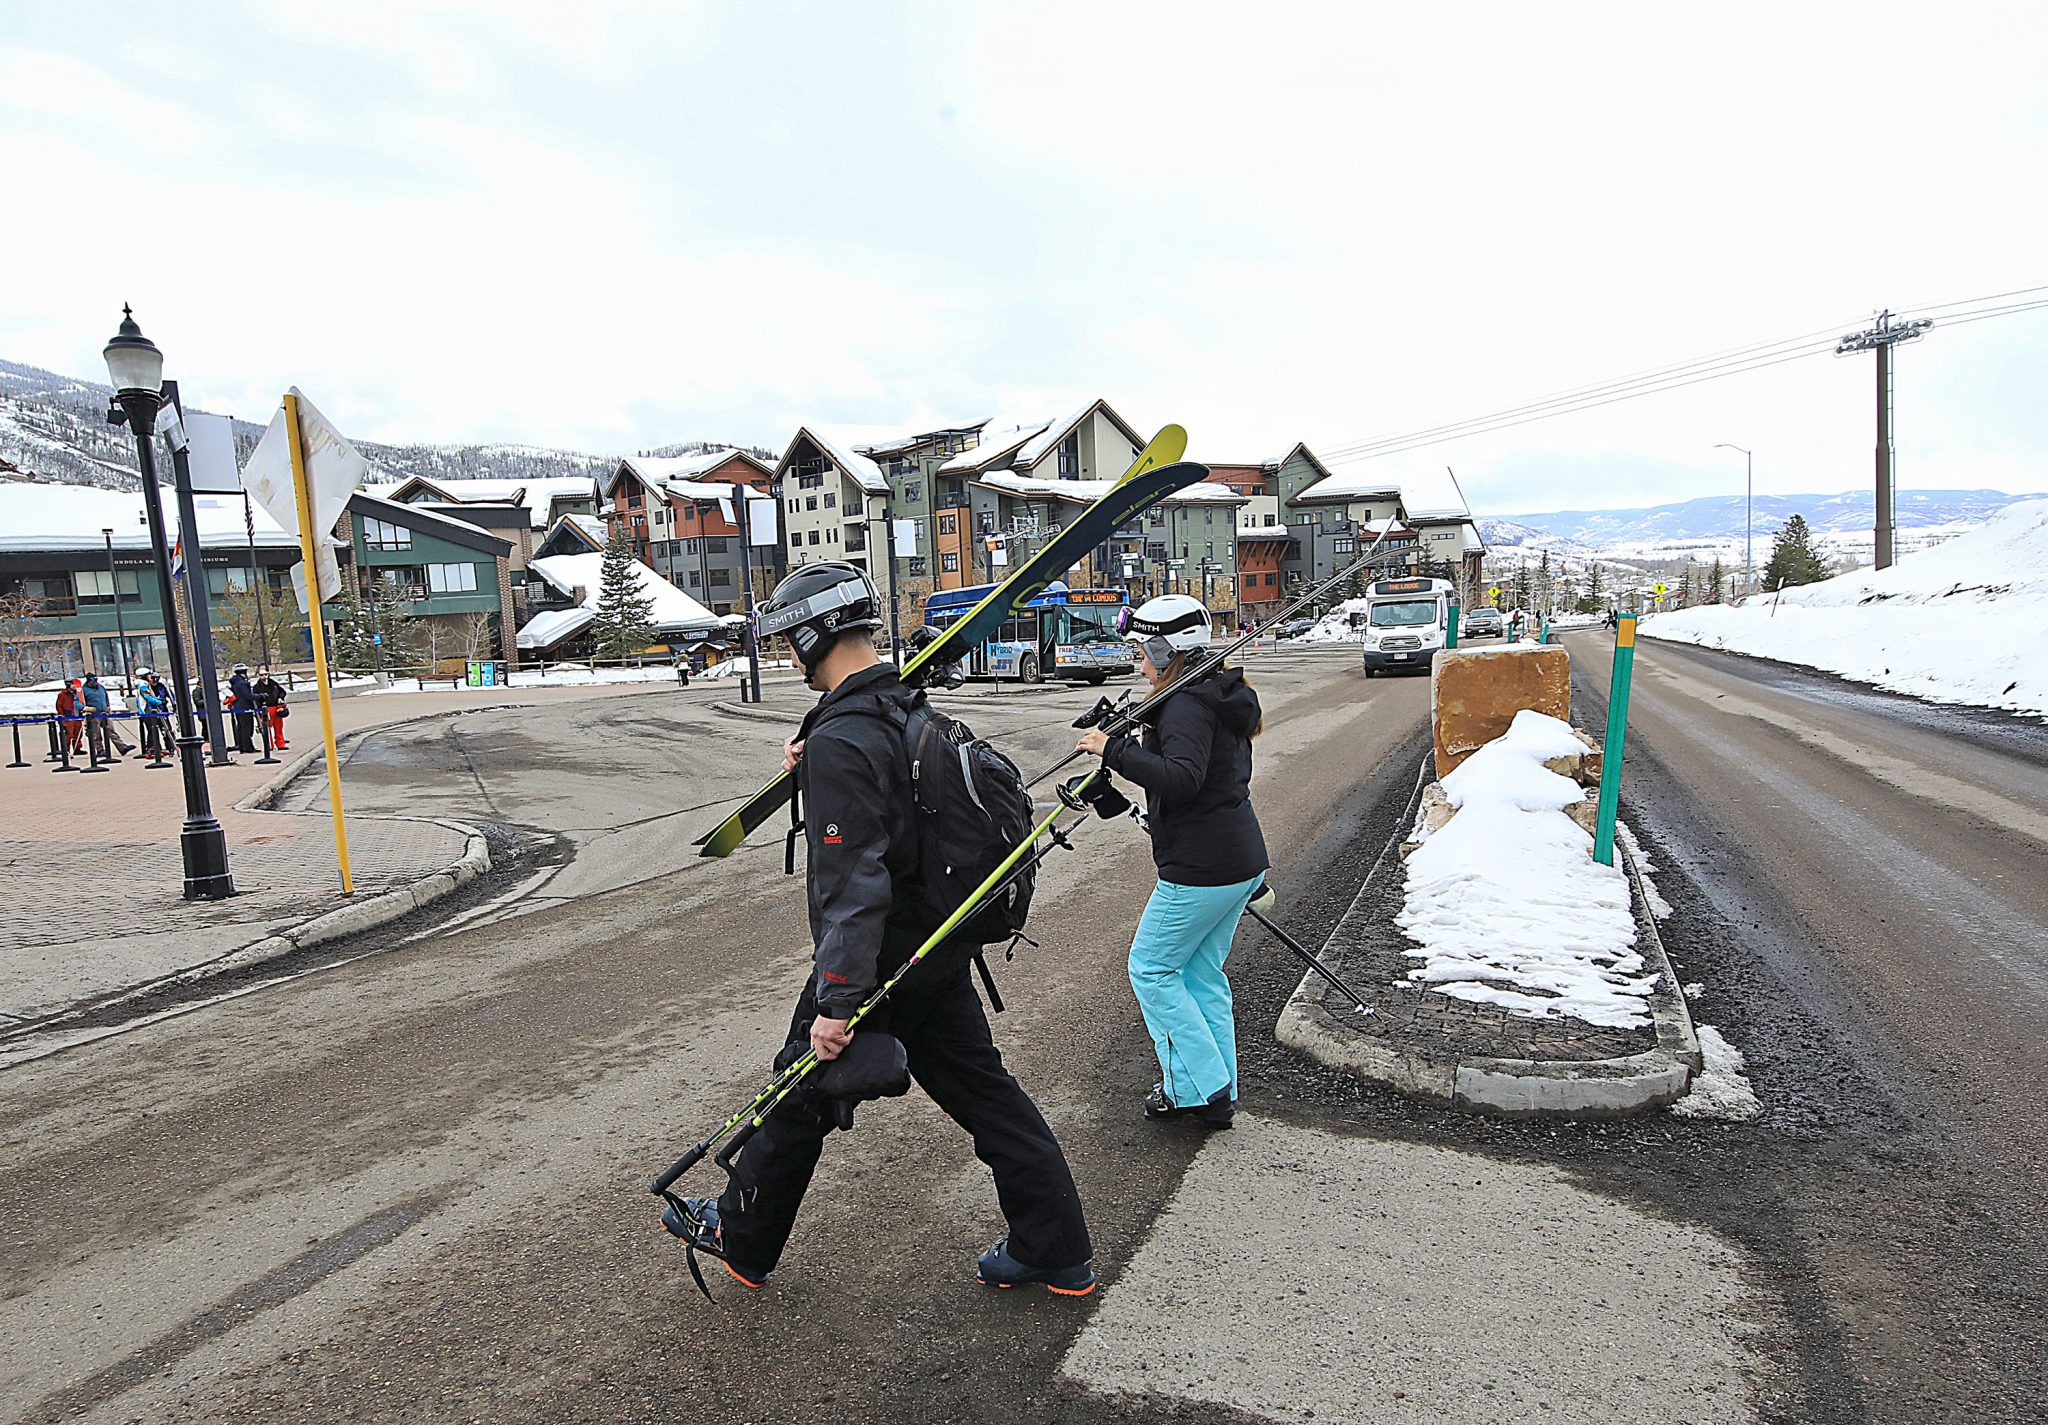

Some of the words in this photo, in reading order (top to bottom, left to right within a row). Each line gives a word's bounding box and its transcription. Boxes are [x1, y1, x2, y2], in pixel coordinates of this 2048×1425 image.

[1093, 593, 1117, 602] CONDOS
[768, 606, 805, 628] SMITH
[1132, 621, 1160, 632] SMITH
